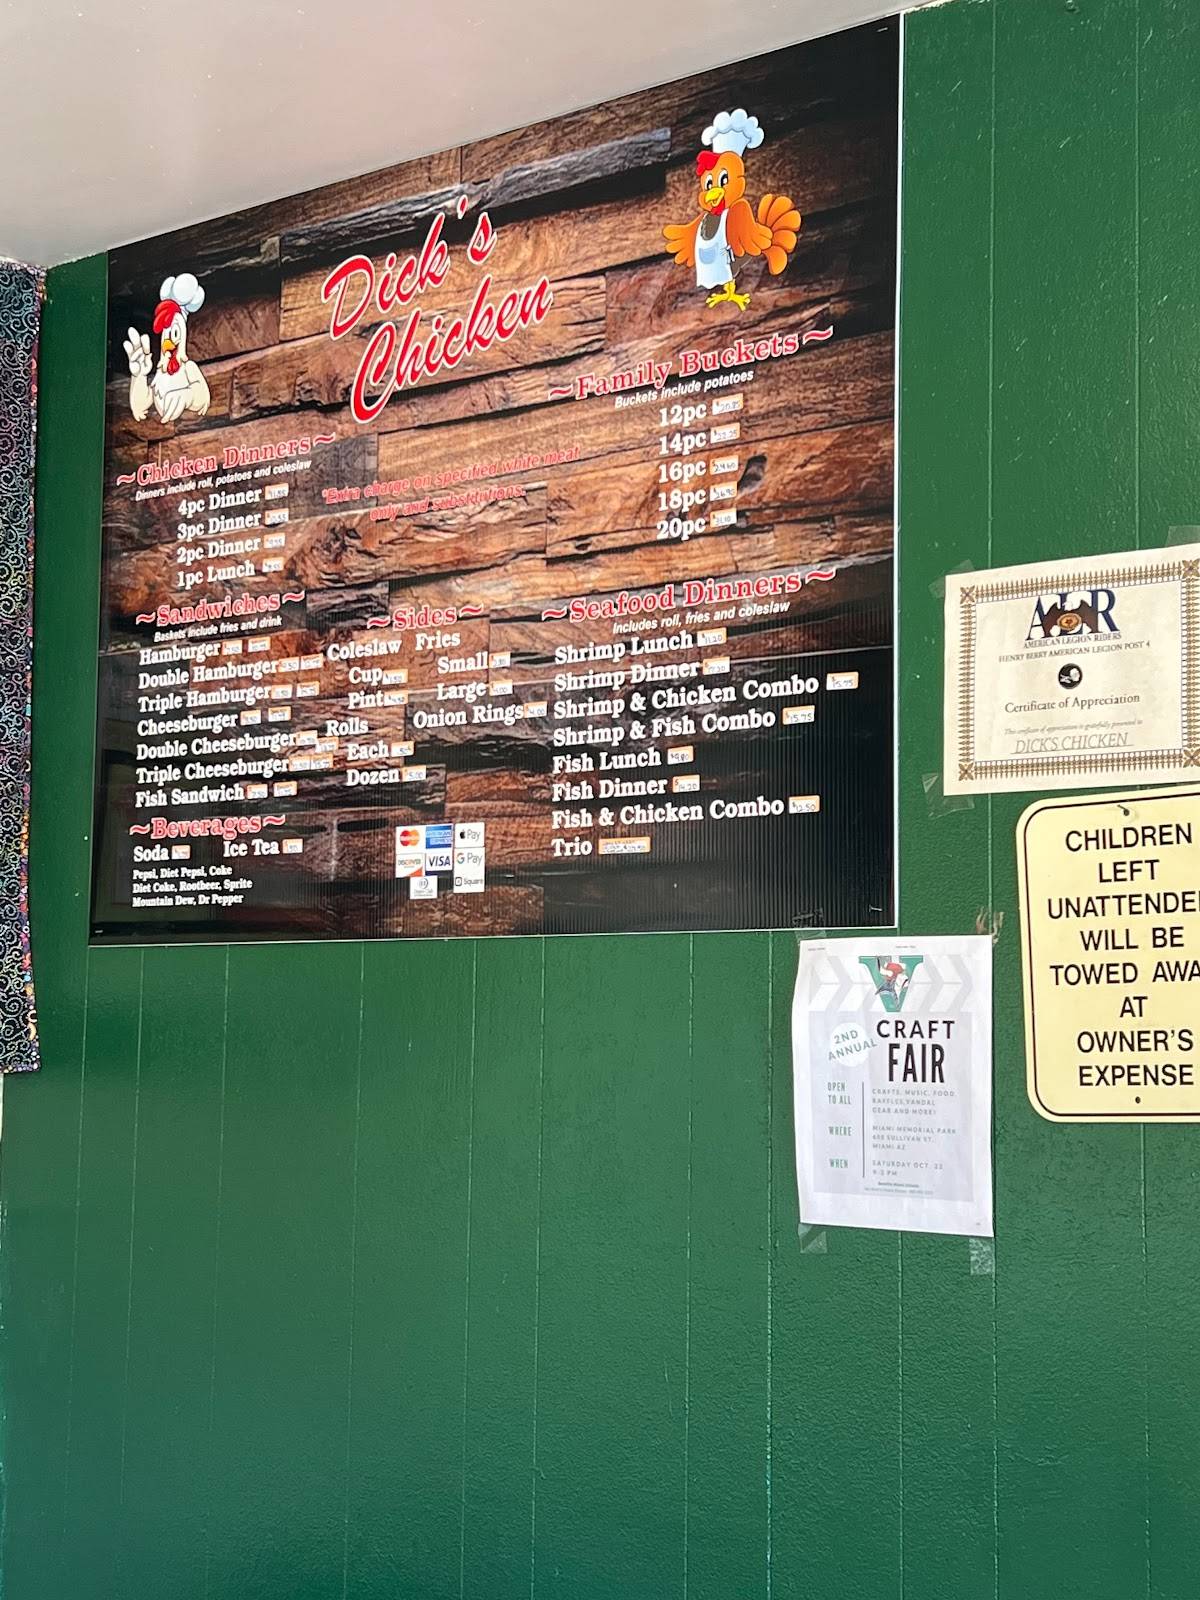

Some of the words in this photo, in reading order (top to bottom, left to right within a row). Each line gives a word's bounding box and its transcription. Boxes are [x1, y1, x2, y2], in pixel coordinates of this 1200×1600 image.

[321, 194, 497, 341] Dick's
[350, 273, 553, 424] Chicken
[615, 390, 657, 408] Buckets
[661, 380, 701, 400] include
[704, 369, 753, 392] potatoes
[659, 403, 707, 427] 12pc
[659, 432, 707, 456] 14pc
[136, 484, 165, 501] Dinners
[167, 480, 195, 496] include
[198, 476, 214, 490] roll,
[216, 471, 252, 487] potatoes
[254, 465, 271, 479] and
[273, 459, 312, 475] coleslaw
[364, 478, 410, 498] charge
[414, 473, 431, 488] on
[436, 463, 497, 488] specified
[500, 454, 538, 475] white
[544, 446, 580, 465] meat
[658, 460, 706, 484] 16pc
[178, 496, 204, 518] 4pc
[208, 487, 262, 511] Dinner
[369, 505, 399, 522] only
[403, 497, 429, 514] and
[658, 488, 706, 512] 18pc
[177, 522, 204, 543] 3pc
[208, 512, 262, 535] Dinner
[657, 517, 706, 540] 20pc
[177, 546, 204, 567] 2pc
[208, 536, 261, 558] Dinner
[177, 570, 203, 590] 1pc
[207, 560, 255, 585] Lunch
[661, 612, 682, 628] roll,
[685, 606, 710, 624] fries
[714, 605, 735, 621] and
[738, 600, 790, 617] coleslaw
[154, 629, 186, 642] Baskets
[188, 624, 218, 638] include
[220, 621, 239, 634] fries
[241, 618, 258, 630] and
[260, 615, 282, 628] drink
[327, 639, 402, 661] Coleslaw
[416, 631, 461, 651] Fries
[554, 639, 625, 665] Shrimp
[631, 631, 693, 657] Lunch
[1023, 638, 1060, 651] AMERICAN
[1061, 634, 1092, 645] LEGION
[1094, 632, 1122, 642] RIDERS
[1048, 646, 1090, 657] AMERICAN
[1092, 644, 1122, 654] LEGION
[1124, 641, 1144, 650] POST
[1146, 640, 1151, 649] 4
[139, 642, 220, 666] Hamburger
[438, 651, 488, 674] Small
[138, 668, 189, 690] Double
[193, 658, 279, 683] Hamburger
[349, 666, 383, 686] Cup
[554, 668, 624, 693] Shrimp
[630, 659, 700, 684] Dinner
[138, 693, 183, 714] Triple
[186, 684, 271, 708] Hamburger
[348, 690, 384, 709] Pint
[436, 681, 487, 703] Large
[554, 696, 624, 720] Shrimp
[652, 682, 737, 709] Chicken
[743, 674, 819, 700] Combo
[1004, 700, 1056, 713] Certificate
[1058, 697, 1069, 709] of
[1072, 693, 1140, 711] Appreciation
[137, 713, 238, 737] Cheeseburger
[326, 717, 369, 737] Rolls
[413, 709, 467, 729] Onion
[472, 702, 524, 726] Rings
[553, 723, 624, 747] Shrimp
[652, 713, 696, 737] Fish
[701, 709, 775, 733] Combo
[136, 741, 188, 760] Double
[191, 732, 296, 756] Cheeseburger
[347, 740, 389, 760] Each
[1061, 732, 1128, 751] CHICKEN
[136, 764, 181, 786] Triple
[184, 757, 290, 781] Cheeseburger
[553, 752, 594, 775] Fish
[599, 747, 662, 770] Lunch
[346, 767, 399, 786] Dozen
[135, 788, 167, 808] Fish
[171, 782, 245, 801] Sandwich
[552, 780, 594, 802] Fish
[599, 777, 668, 798] Dinner
[552, 807, 593, 830] Fish
[620, 802, 704, 825] Chicken
[709, 796, 784, 819] Combo
[467, 829, 481, 841] Pay
[551, 837, 592, 857] Trio
[1065, 823, 1193, 852] CHILDREN
[133, 845, 169, 862] Soda
[223, 840, 248, 858] Ice
[251, 839, 280, 857] Tea
[467, 852, 483, 867] Pay
[132, 868, 158, 881] Pepsi,
[160, 867, 179, 878] Diet
[180, 866, 207, 879] Pepsi,
[209, 864, 233, 876] Coke
[428, 855, 451, 867] VISA
[1098, 859, 1160, 883] LEFT
[132, 883, 151, 893] Diet
[153, 881, 178, 892] Coke,
[179, 880, 222, 891] Rootbeer,
[223, 878, 253, 892] Sprite
[463, 877, 483, 887] Square
[132, 895, 174, 907] Mountain
[175, 895, 196, 906] Dew,
[198, 894, 211, 905] Dr
[211, 894, 244, 906] Pepper
[1047, 891, 1200, 920] UNATTENDE
[1080, 929, 1139, 951] WILL
[1152, 926, 1184, 949] BE
[1050, 962, 1138, 986] TOWED
[1119, 996, 1148, 1018] AT
[834, 1029, 858, 1045] 2ND
[876, 1019, 955, 1039] CRAFT
[1077, 1029, 1194, 1053] OWNER'S
[828, 1038, 878, 1061] ANNUAL
[888, 1043, 945, 1083] FAIR
[1078, 1063, 1194, 1087] EXPENSE
[827, 1081, 846, 1092] OPEN
[828, 1094, 837, 1105] TO
[839, 1095, 852, 1105] ALL
[828, 1126, 853, 1137] WHERE
[829, 1158, 849, 1168] WHEN
